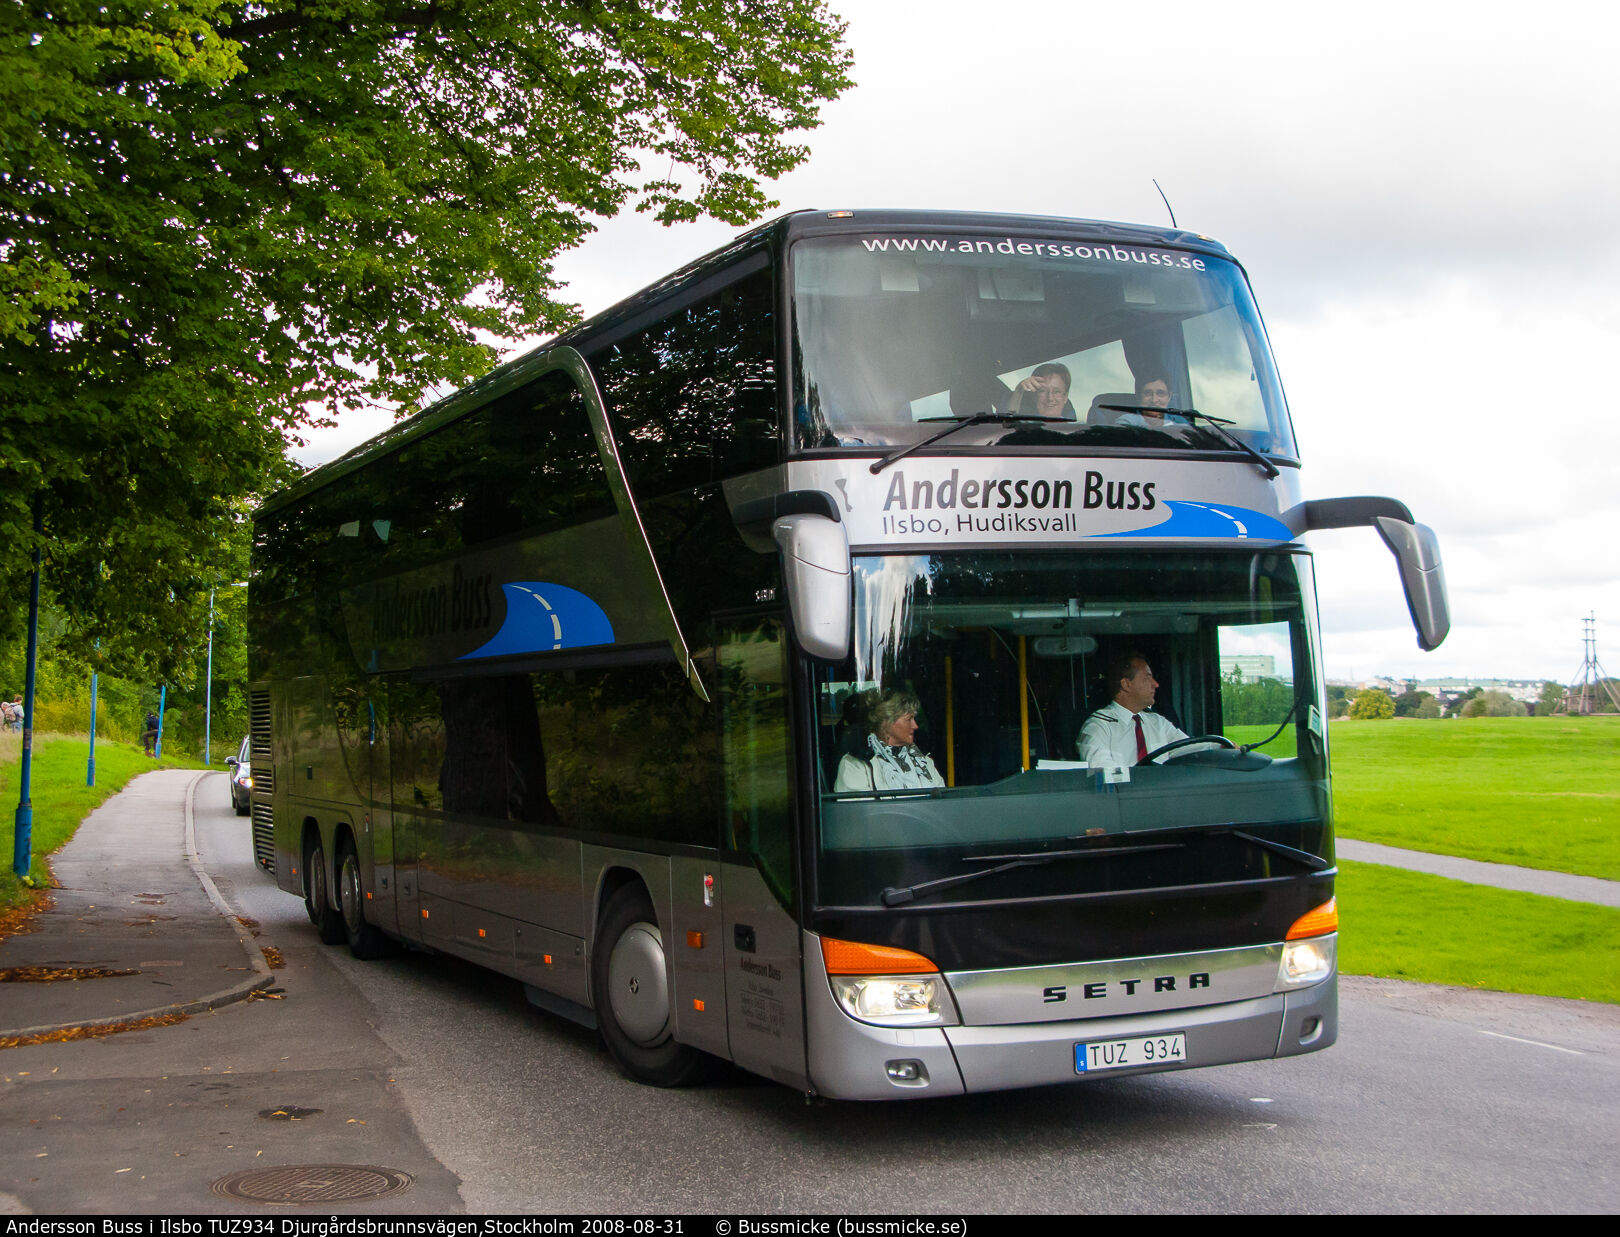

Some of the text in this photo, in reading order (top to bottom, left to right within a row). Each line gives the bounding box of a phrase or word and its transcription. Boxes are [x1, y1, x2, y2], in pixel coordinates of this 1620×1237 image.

[861, 238, 1206, 272] www.anderssonbuss.se
[882, 468, 1156, 512] Andersson Buss
[883, 513, 1077, 536] Ilsbo, Hudiksvall
[451, 562, 492, 633] Buss
[1043, 972, 1210, 1003] SETRA
[1089, 1037, 1182, 1066] TUZ 934
